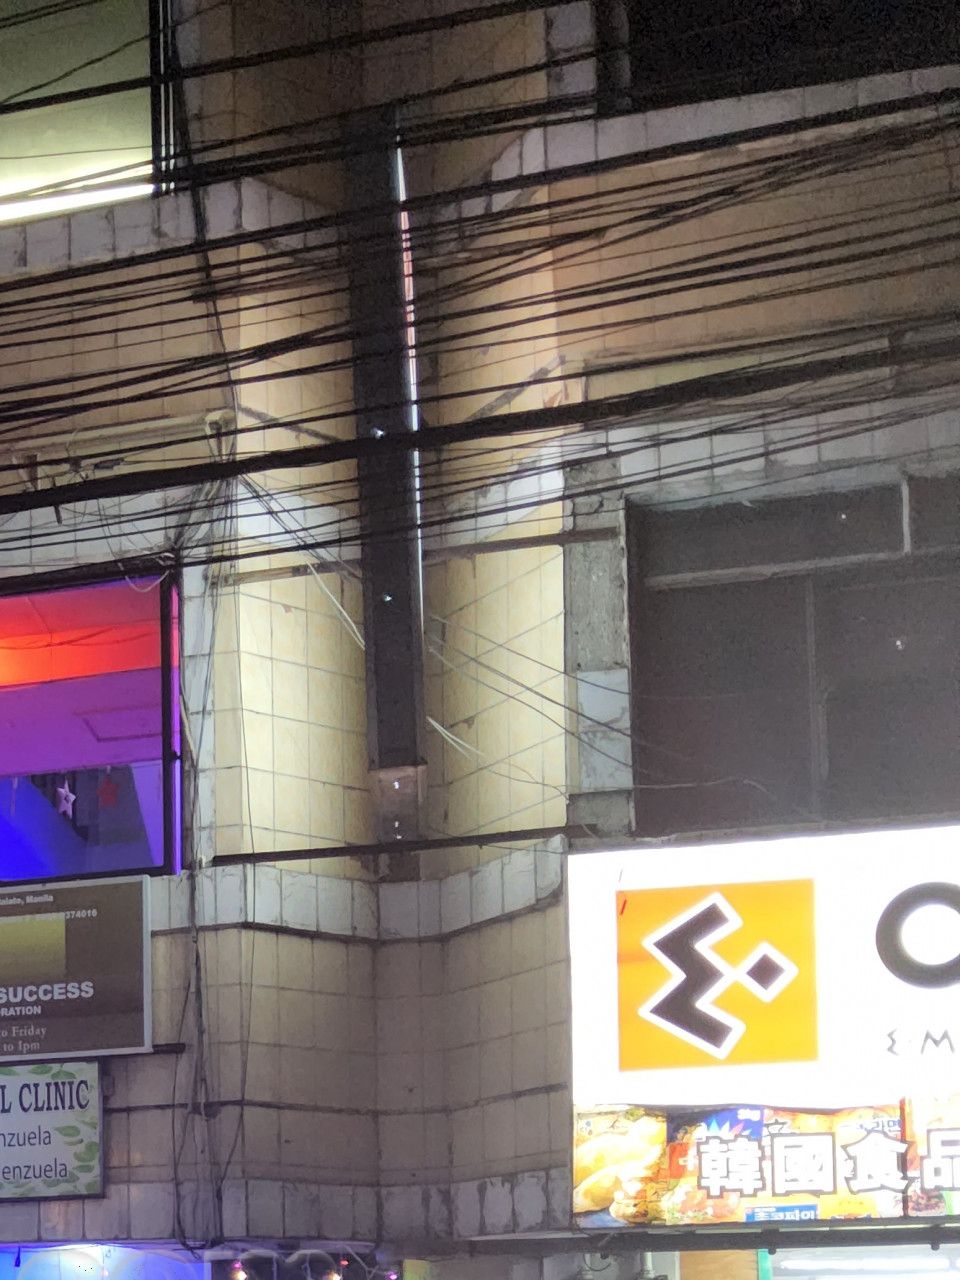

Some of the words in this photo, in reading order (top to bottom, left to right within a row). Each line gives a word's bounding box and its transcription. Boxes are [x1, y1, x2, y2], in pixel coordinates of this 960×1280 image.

[12, 1024, 47, 1038] Friday
[3, 1041, 14, 1052] to
[18, 1040, 40, 1053] 1pm
[18, 1080, 90, 1113] CLINIC
